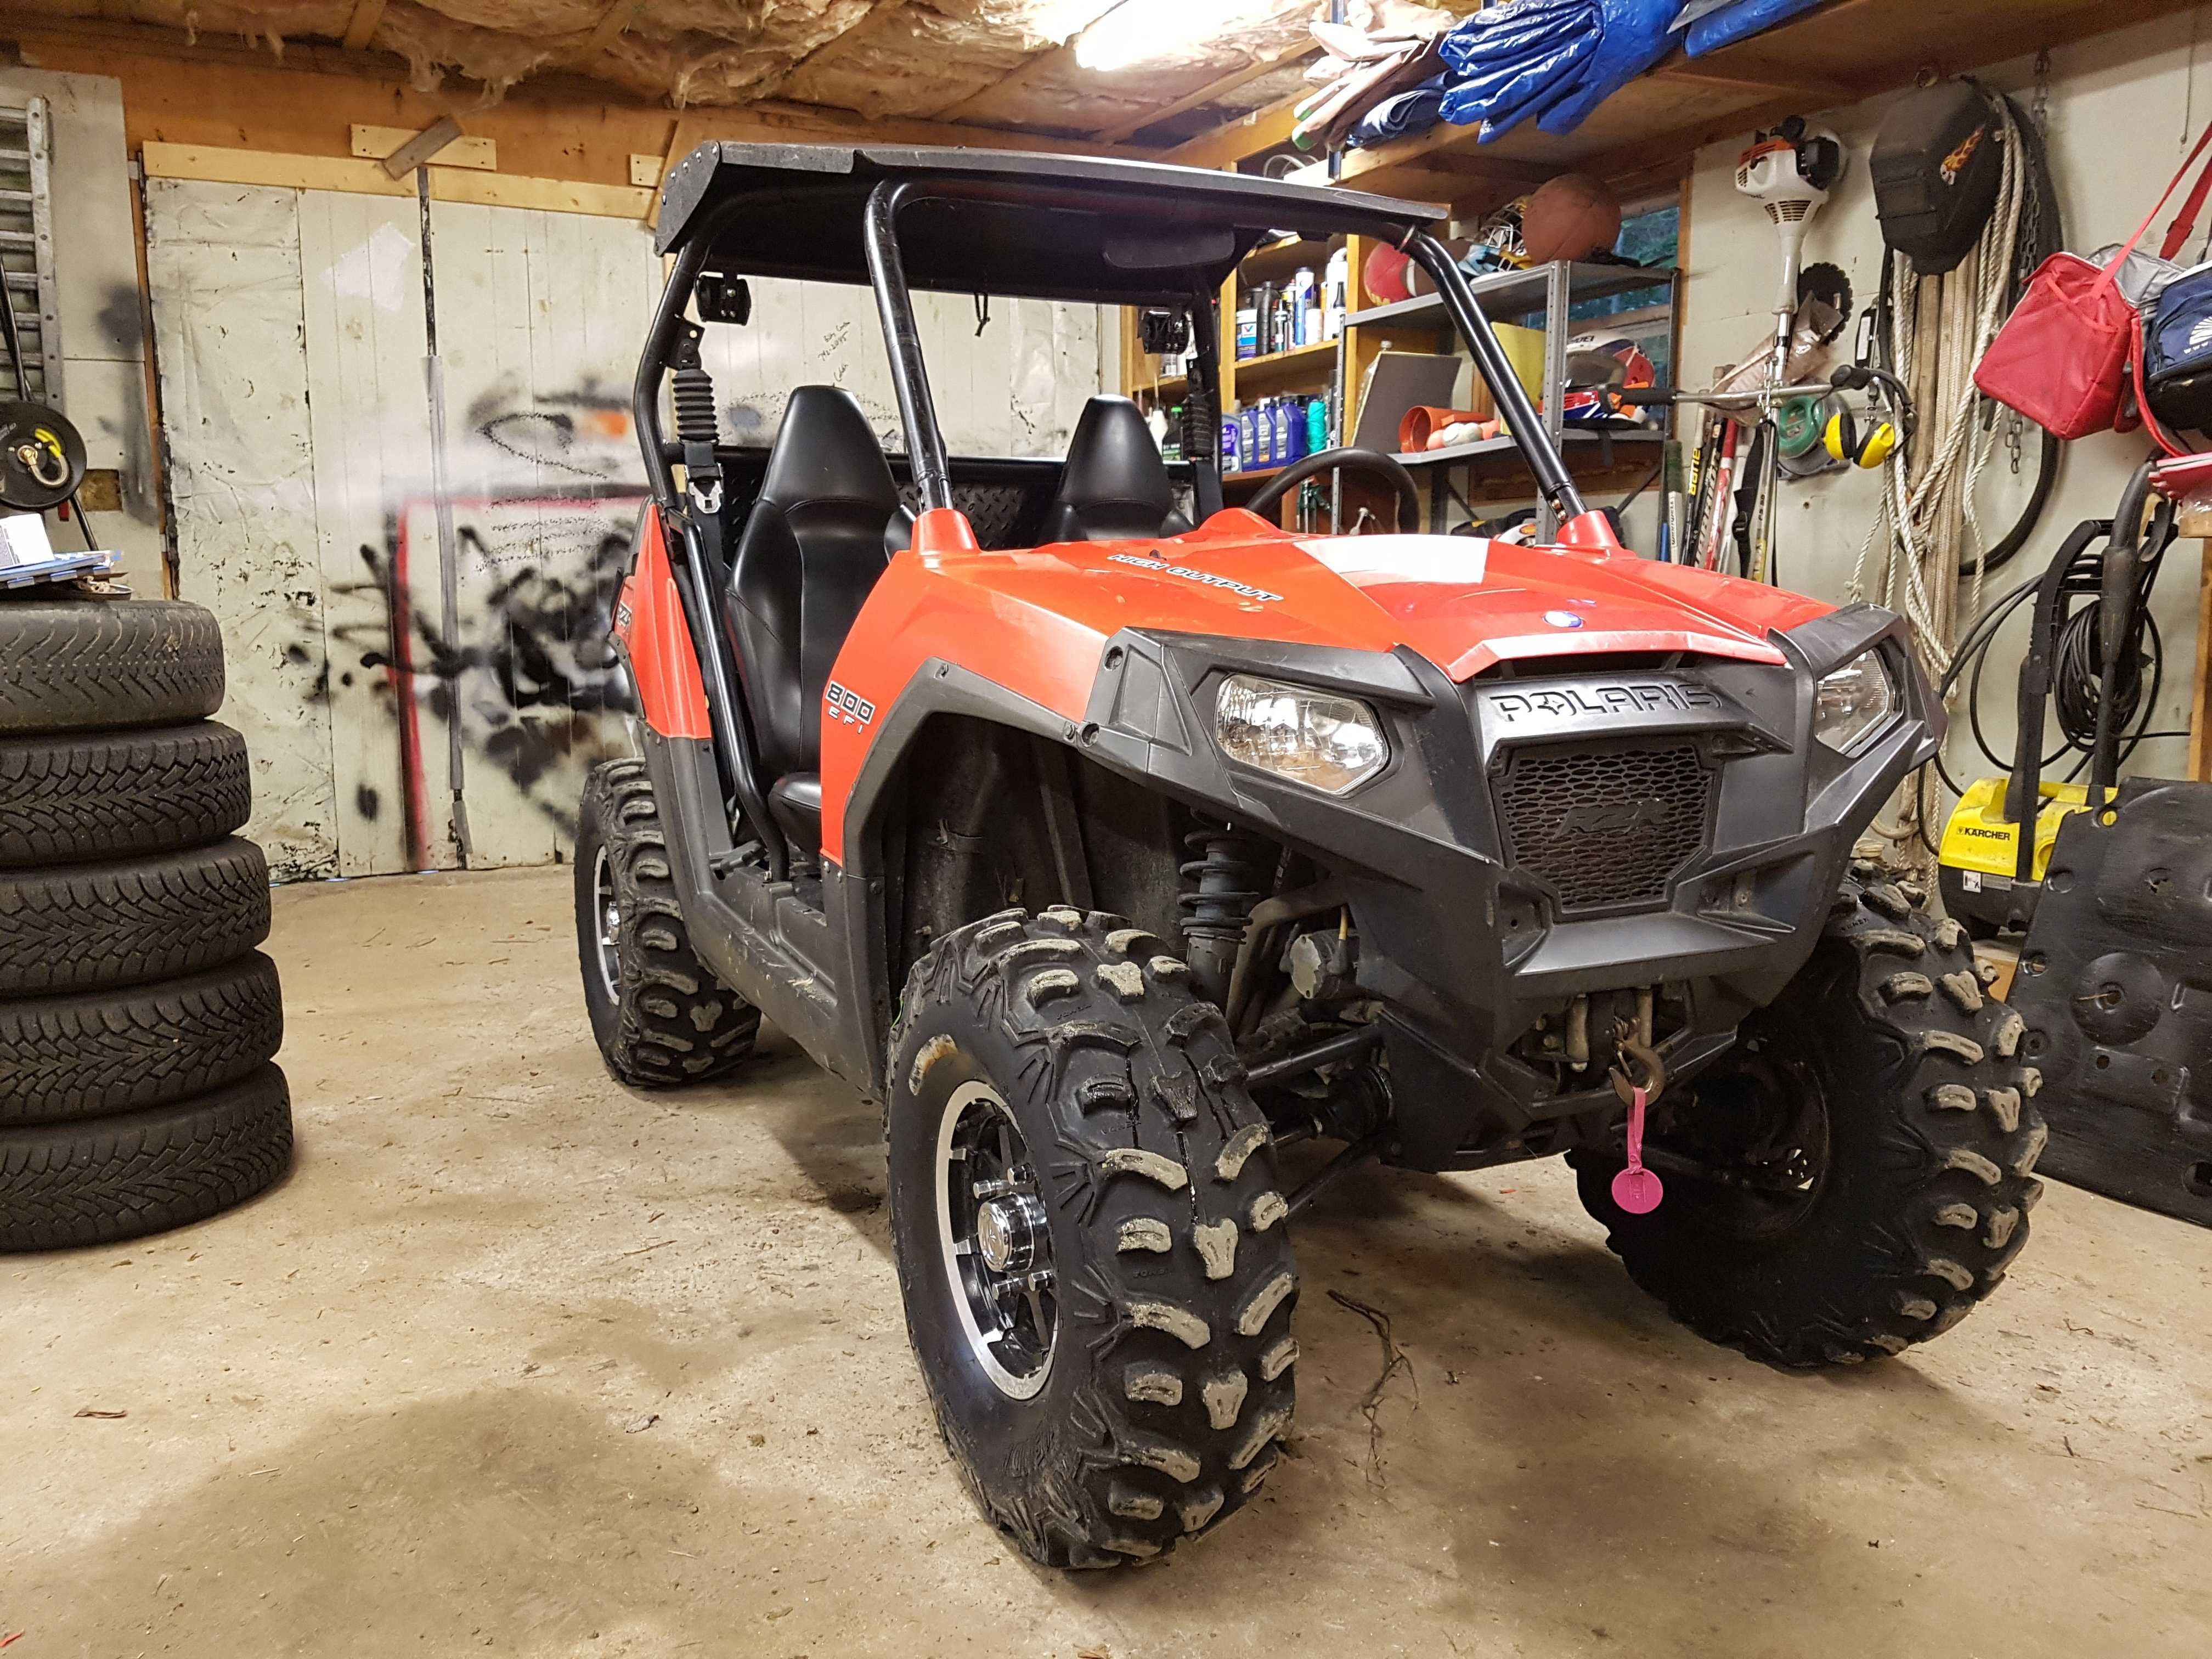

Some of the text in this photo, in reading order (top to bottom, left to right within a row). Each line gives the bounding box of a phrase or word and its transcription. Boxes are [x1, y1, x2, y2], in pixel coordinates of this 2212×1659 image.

[1107, 554, 1284, 601] HIGH OUTPUT
[825, 681, 876, 725] 800
[828, 706, 864, 734] EFI
[1489, 683, 1722, 723] POLARIS
